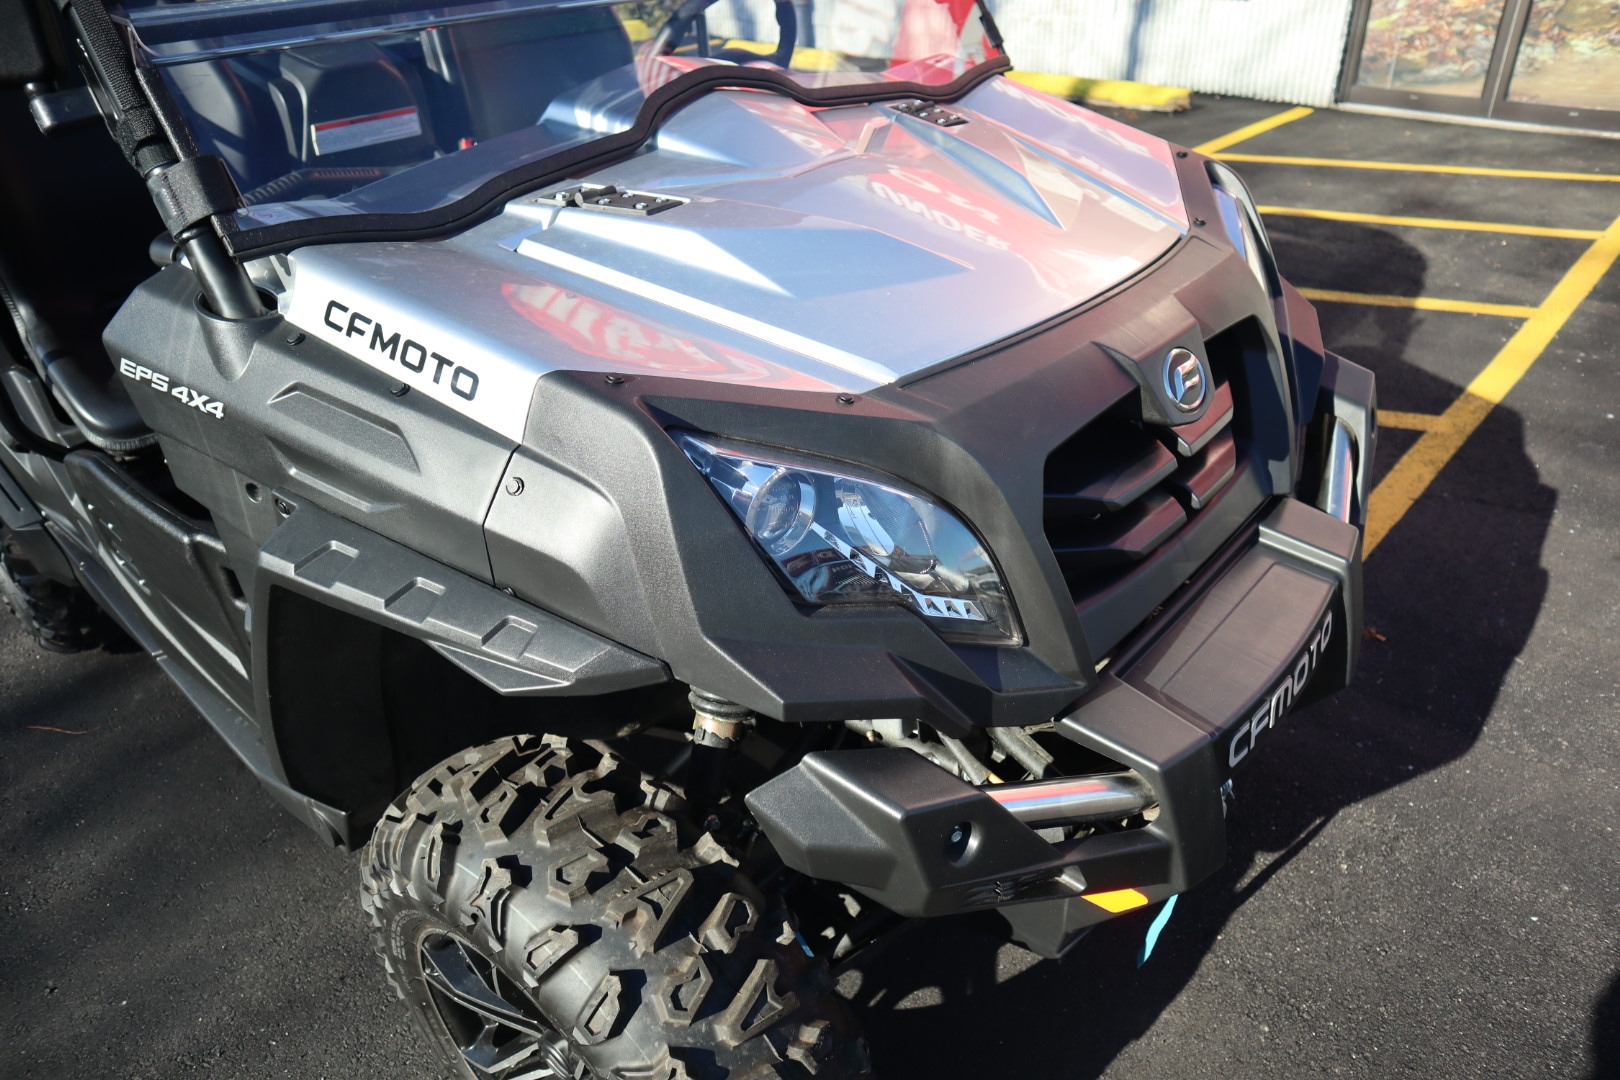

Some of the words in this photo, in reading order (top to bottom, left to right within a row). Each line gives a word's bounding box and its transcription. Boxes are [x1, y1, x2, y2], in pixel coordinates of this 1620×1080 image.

[120, 357, 168, 393] EPS
[171, 385, 225, 419] 4X4
[323, 299, 479, 401] CFMOTO
[1229, 610, 1332, 767] CFMOTO
